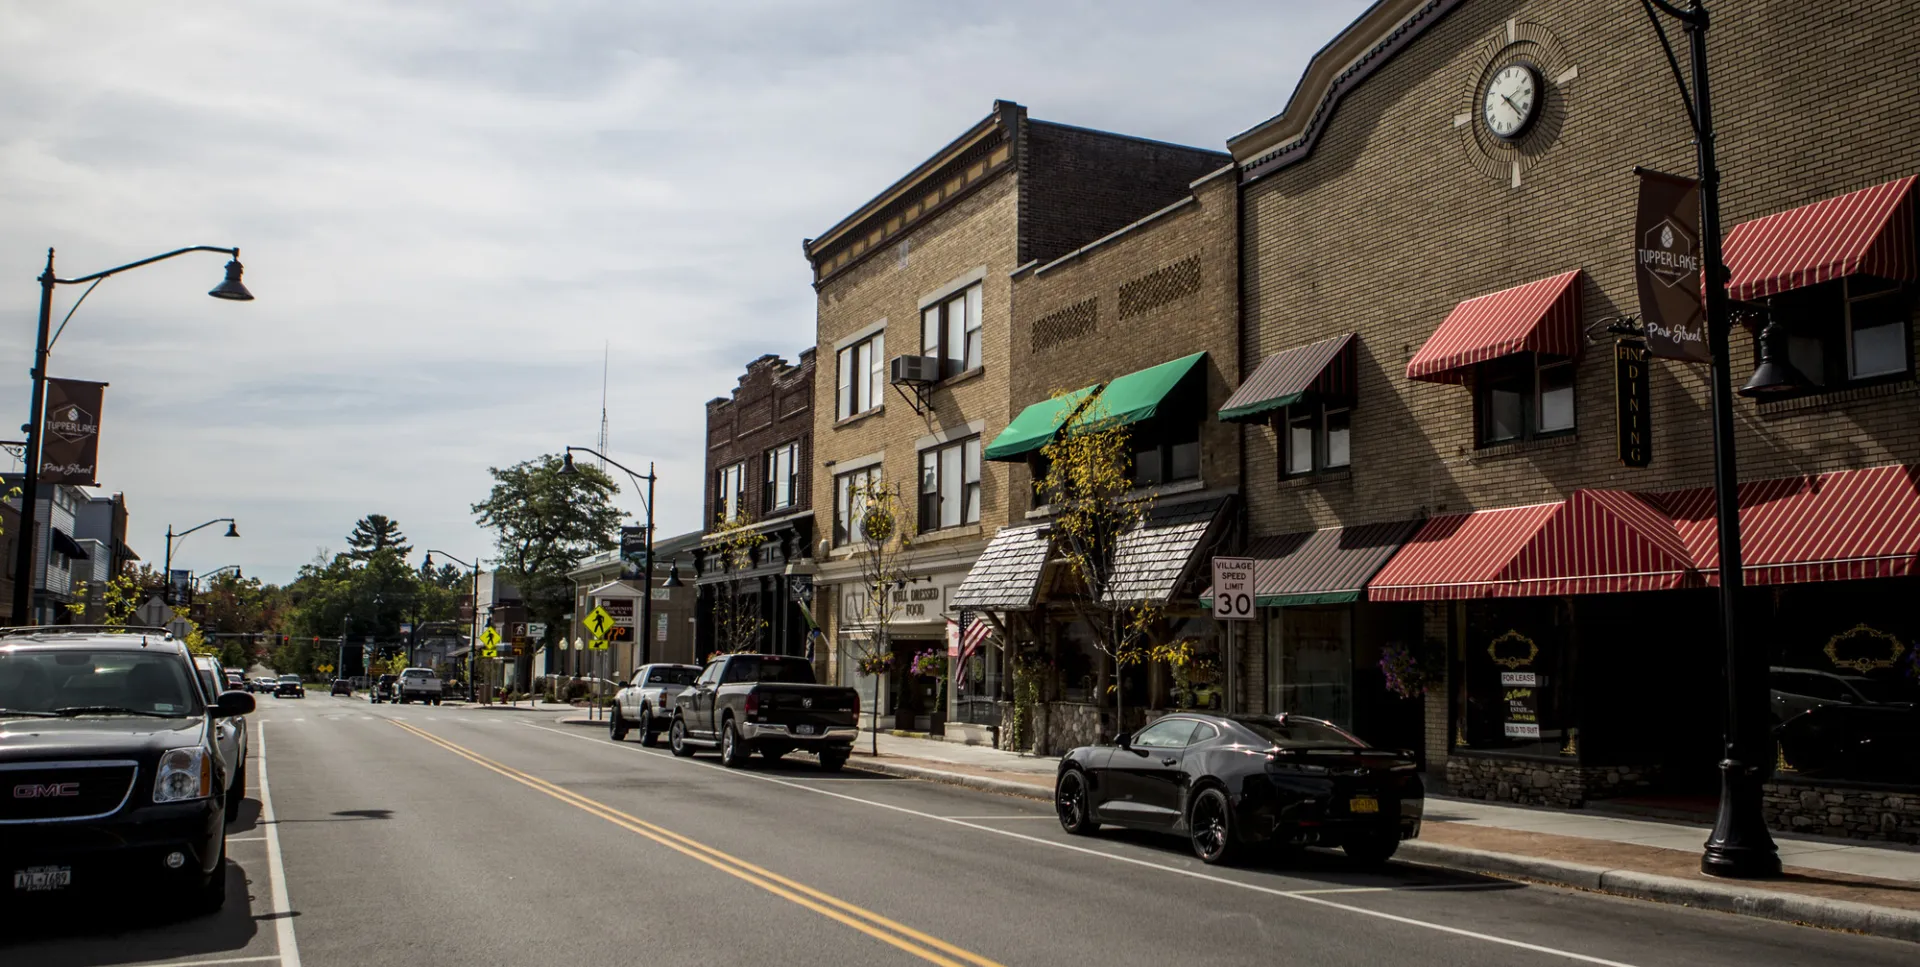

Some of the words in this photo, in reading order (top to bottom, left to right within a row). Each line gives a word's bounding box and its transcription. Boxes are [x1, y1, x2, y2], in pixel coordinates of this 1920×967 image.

[1647, 322, 1672, 338] Park
[1672, 323, 1702, 344] Street
[1629, 365, 1641, 462] DINING
[64, 463, 94, 475] Street
[1216, 562, 1252, 570] VILLAGE
[1222, 572, 1246, 580] SPEED
[893, 591, 908, 602] WELL
[911, 588, 938, 601] DRESSED
[906, 604, 924, 616] FOOD
[1219, 593, 1250, 614] 30
[14, 782, 79, 798] GMC
